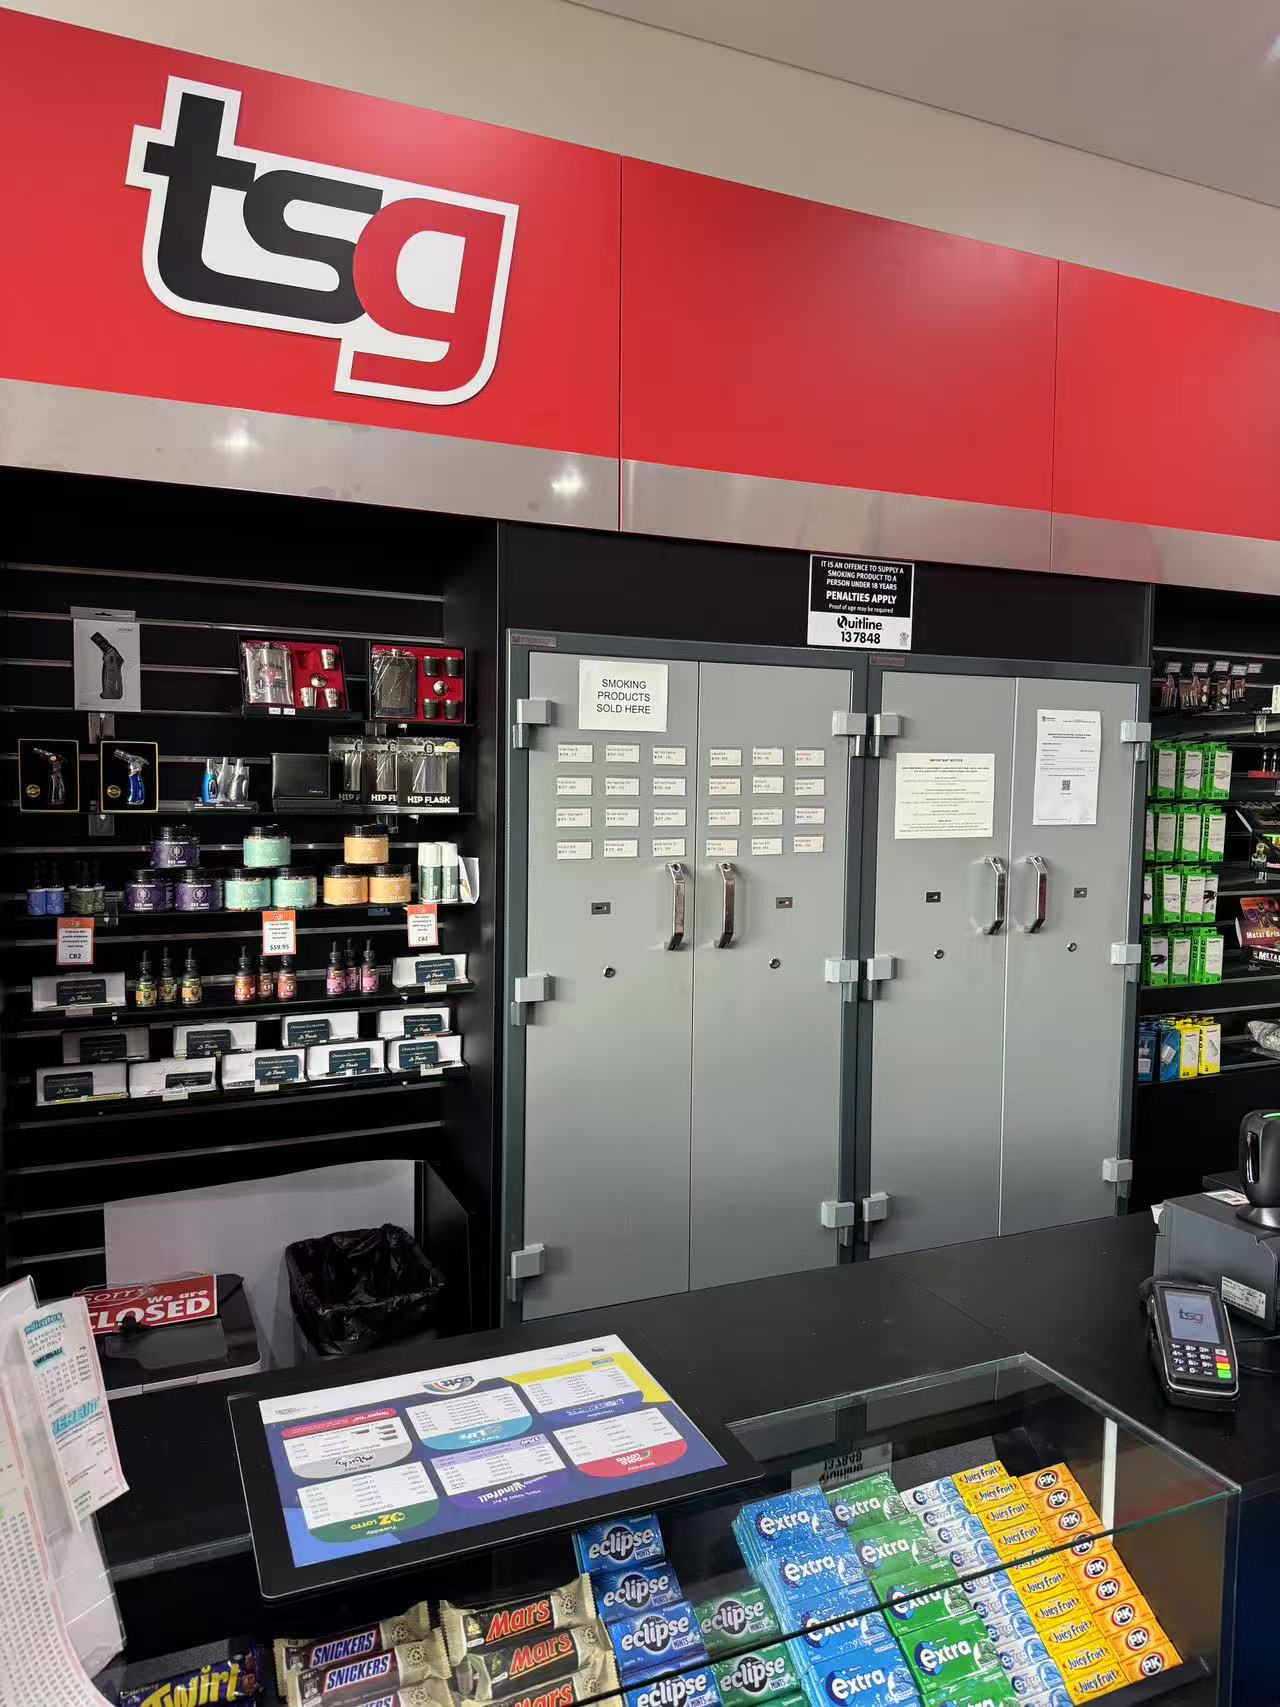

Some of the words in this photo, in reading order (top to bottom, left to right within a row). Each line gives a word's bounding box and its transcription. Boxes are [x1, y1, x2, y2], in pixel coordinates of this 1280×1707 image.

[142, 91, 506, 393] tsg
[828, 570, 855, 579] SMOKING
[857, 572, 884, 581] PRODUCT
[844, 563, 868, 572] OFFENCE
[878, 566, 899, 574] SUPPLY
[827, 579, 850, 587] PERSON
[851, 581, 871, 589] UNDER
[826, 591, 870, 603] PENALTIES
[872, 594, 897, 605] APPLY
[837, 616, 883, 630] Quitline
[602, 679, 647, 690] SMOKING
[598, 691, 651, 702] PRODUCTS
[596, 704, 622, 714] SOLD
[625, 705, 651, 714] HERE
[371, 794, 386, 802] HIP
[408, 796, 423, 804] HIP
[425, 796, 451, 804] FLASK
[1246, 931, 1265, 939] Metal
[147, 1295, 174, 1304] We
[179, 1290, 208, 1299] are
[1178, 1308, 1204, 1324] tsg
[616, 1452, 641, 1463] LOTTO
[623, 1457, 643, 1466] GOLD
[628, 1461, 656, 1471] Saturday
[964, 1471, 981, 1483] Juicy
[981, 1465, 999, 1477] Fruit
[478, 1481, 526, 1503] Windfall
[979, 1487, 996, 1501] Juicy
[996, 1483, 1014, 1494] Fruit
[834, 1497, 882, 1521] extra
[991, 1509, 1008, 1521] Juicy
[1008, 1504, 1027, 1515] Fruit
[351, 1520, 377, 1530] LOTTO
[367, 1526, 397, 1535] Tuesday
[760, 1510, 811, 1535] extra
[588, 1528, 653, 1559] eclipse
[1003, 1532, 1021, 1545] Juicy
[1021, 1527, 1039, 1539] Fruit
[636, 1548, 650, 1558] MINTS
[861, 1539, 911, 1564] extra
[784, 1555, 837, 1582] extra
[603, 1575, 669, 1607] eclipse
[1027, 1581, 1045, 1594] Juicy
[1046, 1573, 1063, 1587] Fruit
[653, 1594, 669, 1605] MINTS
[1040, 1605, 1058, 1618] Juicy
[1058, 1598, 1076, 1612] Fruit
[486, 1600, 551, 1643] Mars
[701, 1601, 764, 1634] eclipse
[750, 1620, 765, 1633] MINTS
[805, 1609, 861, 1642] extra
[622, 1615, 690, 1651] eclipse
[1054, 1630, 1072, 1643] Juicy
[1072, 1622, 1090, 1636] Fruit
[312, 1630, 375, 1667] SNICKERS
[674, 1637, 689, 1649] MINTS
[509, 1633, 572, 1675] Mars
[920, 1640, 972, 1669] extra
[1068, 1656, 1087, 1669] Juicy
[1087, 1648, 1105, 1661] Fruit
[327, 1656, 390, 1691] SNICKERS
[720, 1657, 785, 1692] eclipse
[1079, 1680, 1098, 1693] Juicy
[1098, 1670, 1117, 1684] Fruit
[140, 1664, 240, 1707] Twirl
[637, 1674, 707, 1707] eclipse
[771, 1678, 786, 1689] MINTS
[832, 1668, 886, 1700] extra
[689, 1696, 706, 1707] MINTS
